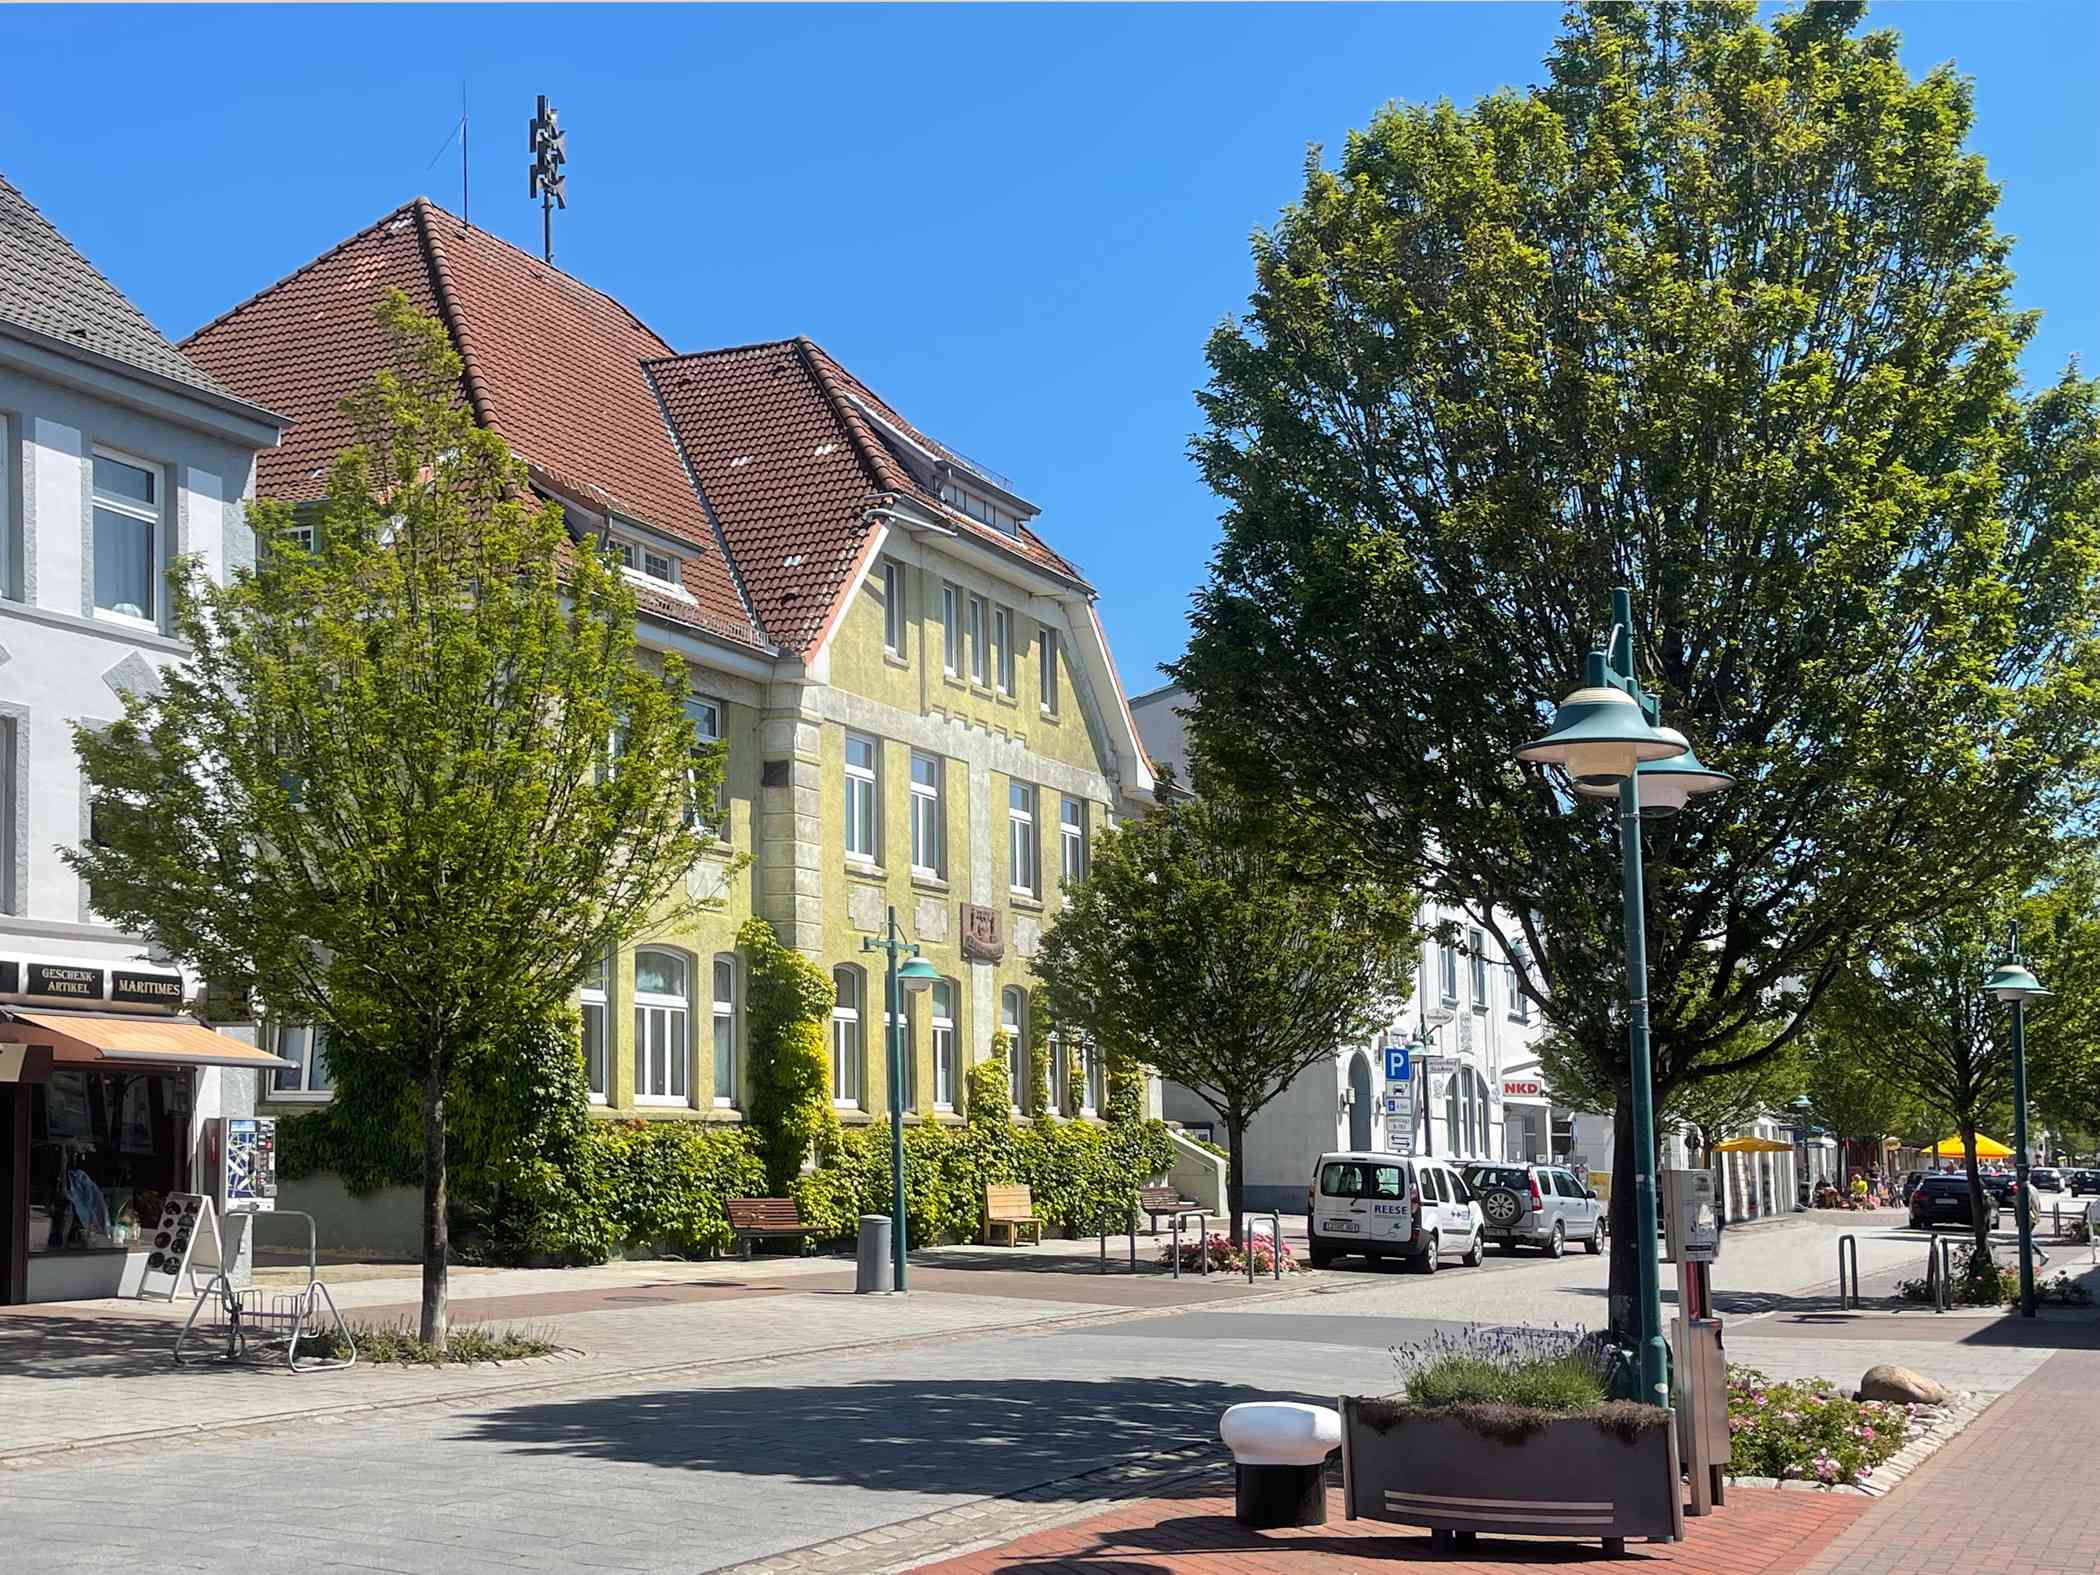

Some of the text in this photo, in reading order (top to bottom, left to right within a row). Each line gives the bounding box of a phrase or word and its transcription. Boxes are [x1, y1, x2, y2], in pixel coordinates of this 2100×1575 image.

[41, 968, 96, 982] GESCHENK-
[47, 981, 91, 994] ARTIKEL
[119, 979, 181, 996] MARITIMES
[1391, 1052, 1404, 1076] P
[1504, 1083, 1538, 1094] NKD
[1374, 1204, 1408, 1215] REESE
